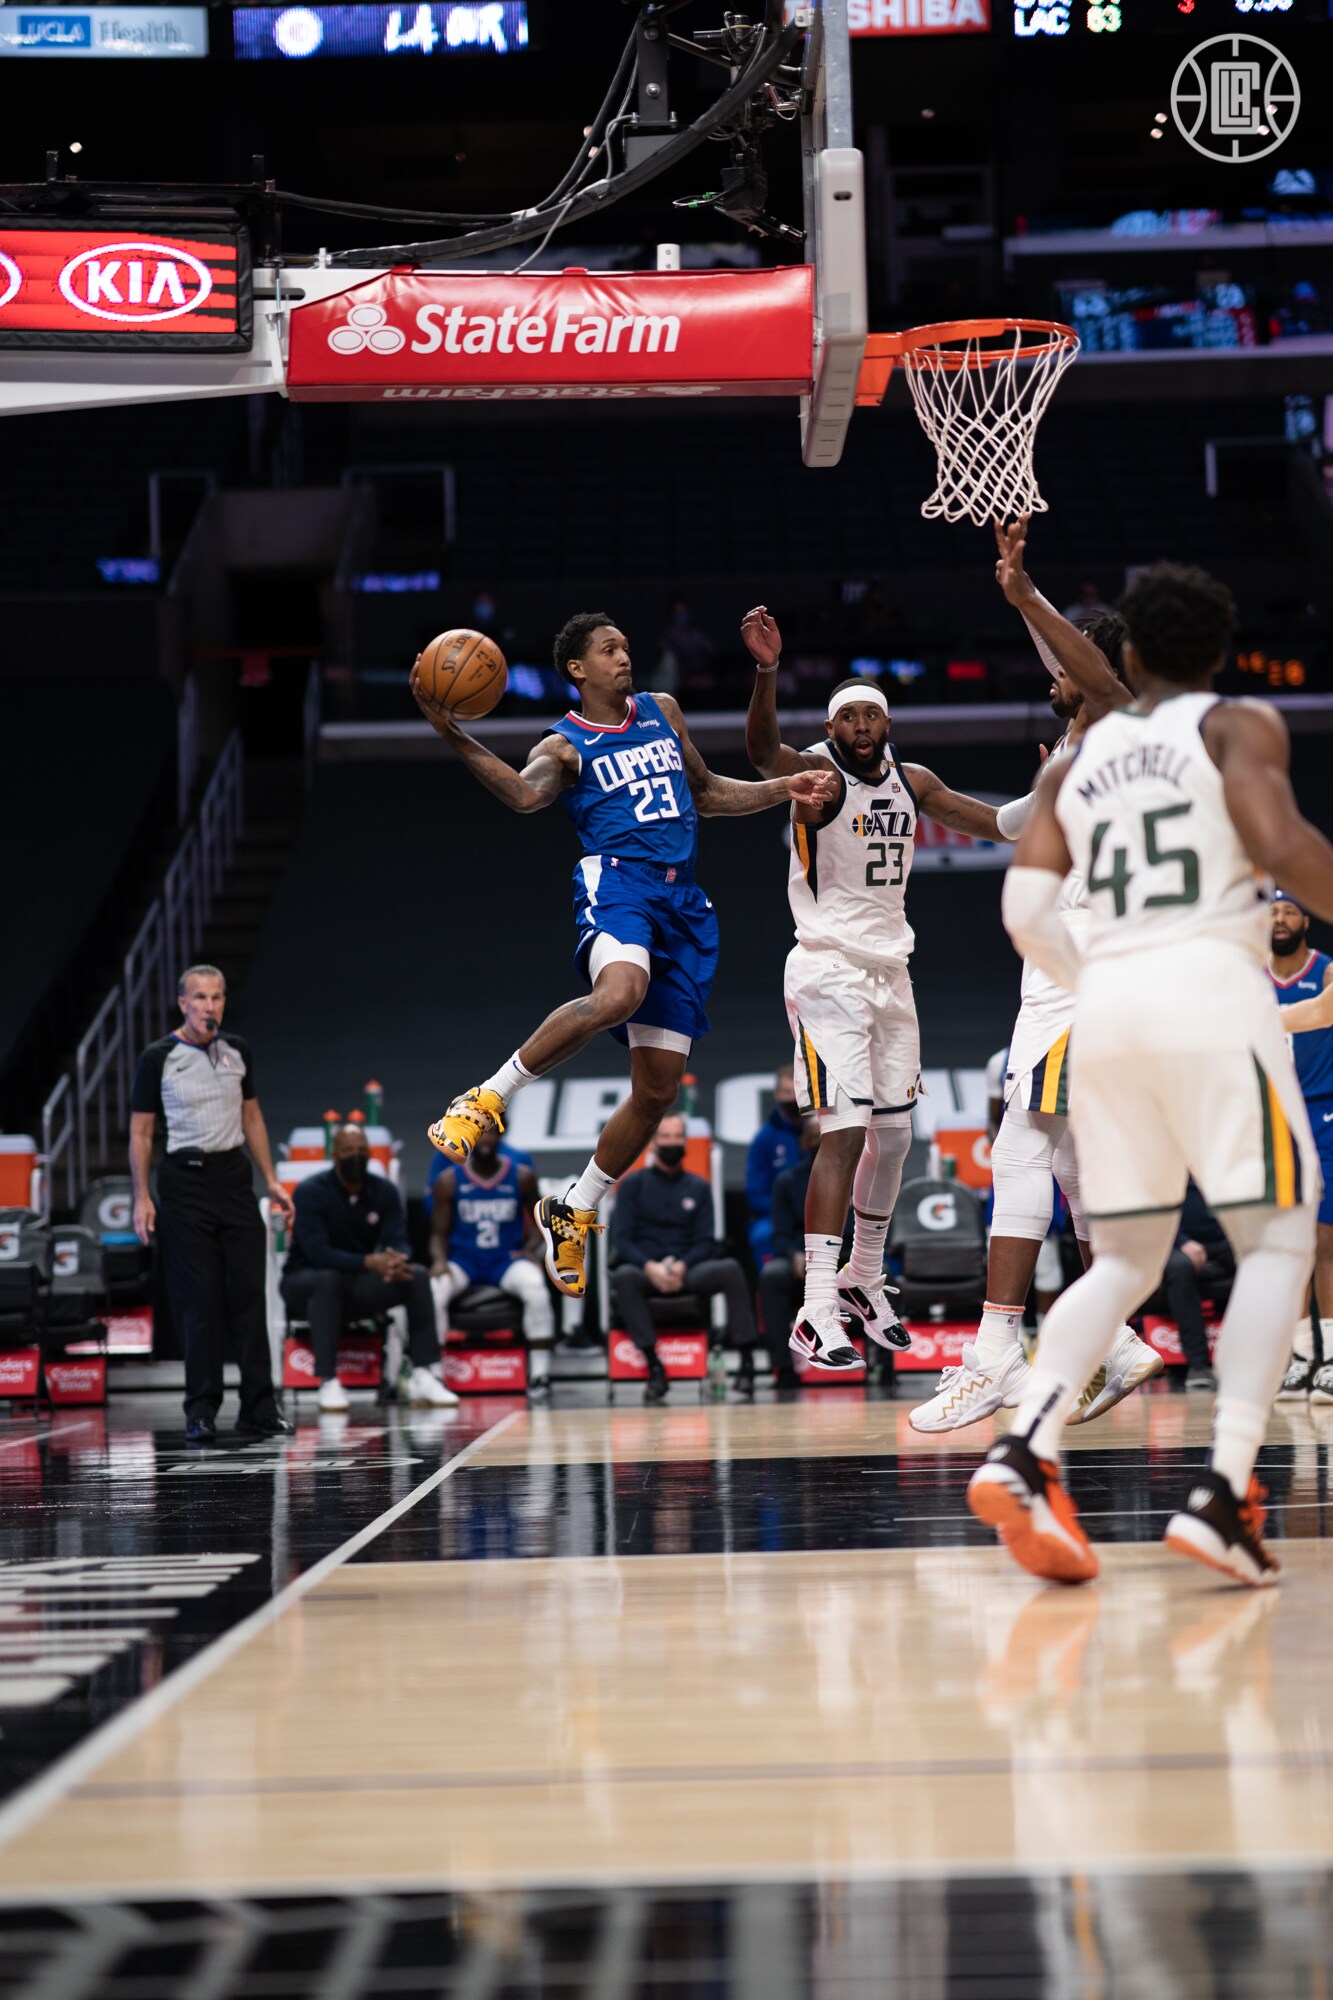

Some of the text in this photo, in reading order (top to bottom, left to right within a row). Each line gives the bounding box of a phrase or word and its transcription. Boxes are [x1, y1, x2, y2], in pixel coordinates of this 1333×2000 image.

[27, 20, 182, 44] UCLA Health
[1014, 7, 1070, 36] LAC
[86, 260, 186, 304] KIA
[591, 738, 683, 793] CLIPPERS
[1077, 744, 1192, 807] MITCHELL
[628, 776, 681, 823] 23
[865, 842, 905, 886] 23
[1088, 801, 1200, 919] 45
[917, 1193, 957, 1230] G
